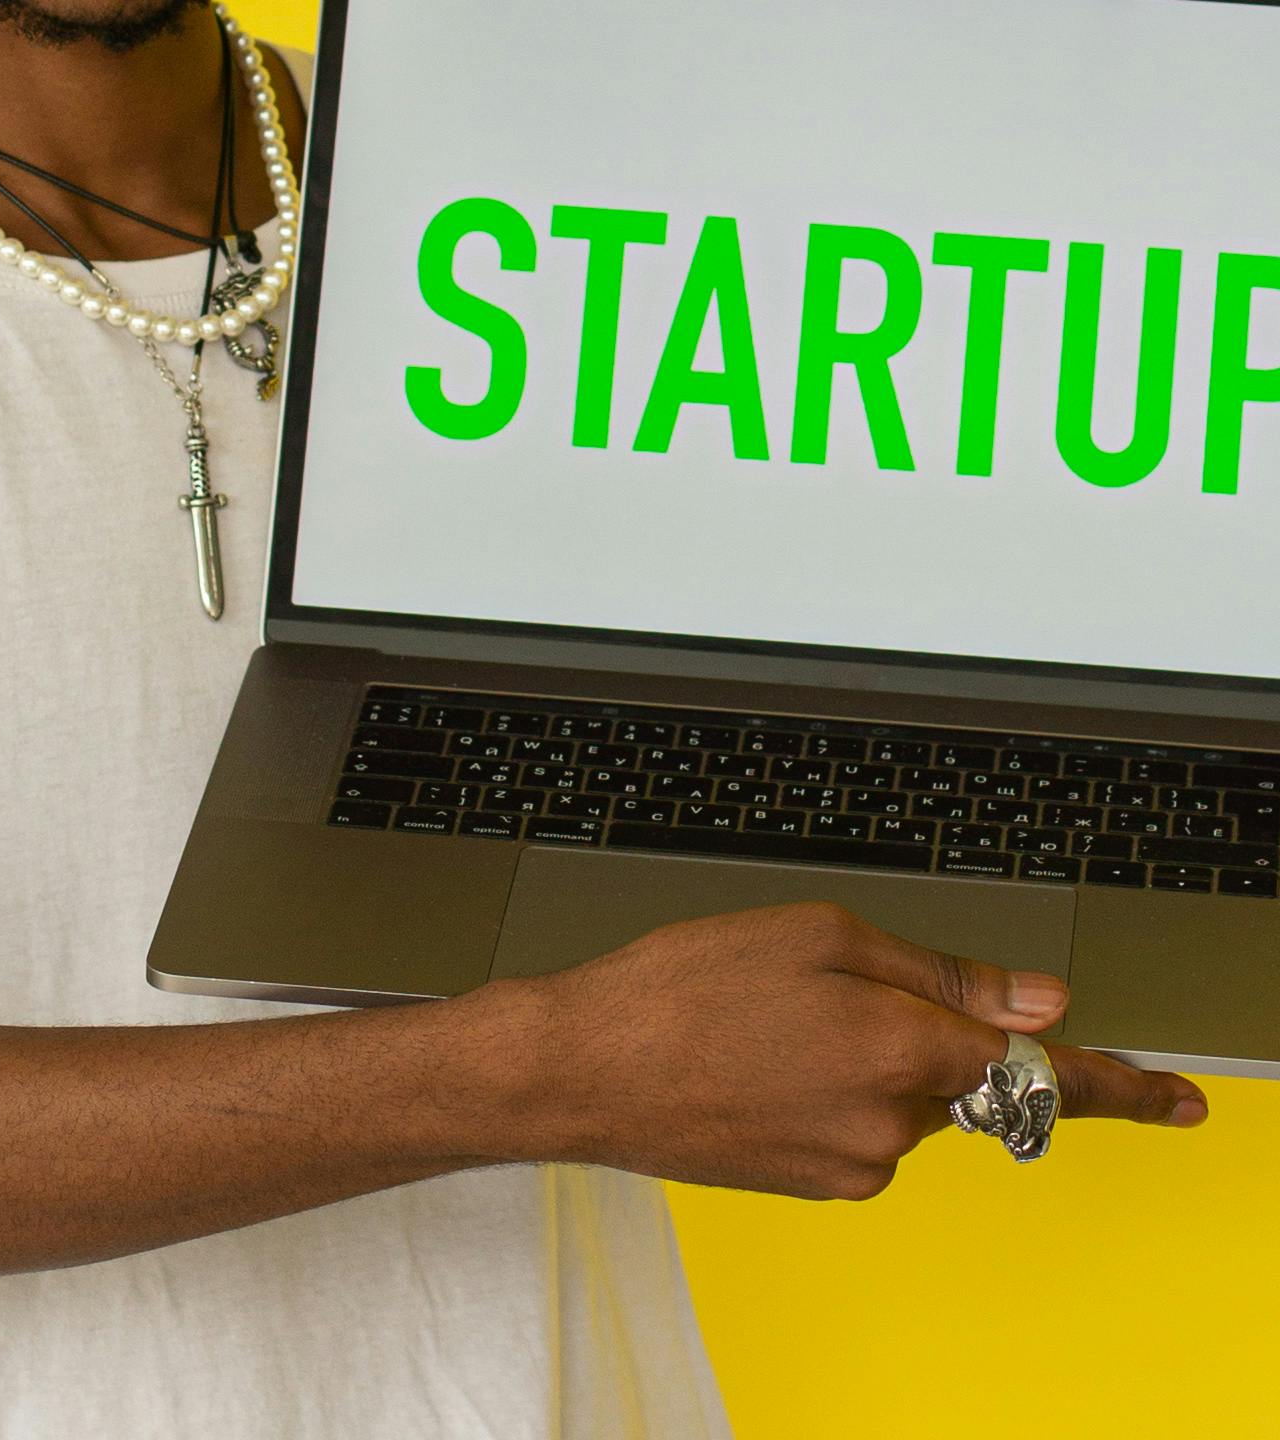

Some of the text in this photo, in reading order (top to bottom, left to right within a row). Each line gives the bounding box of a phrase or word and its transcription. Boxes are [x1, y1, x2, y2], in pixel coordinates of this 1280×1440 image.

[403, 821, 445, 830] control
[472, 827, 510, 835] option
[535, 832, 593, 841] command
[945, 864, 1003, 873] command
[1028, 870, 1066, 878] option
